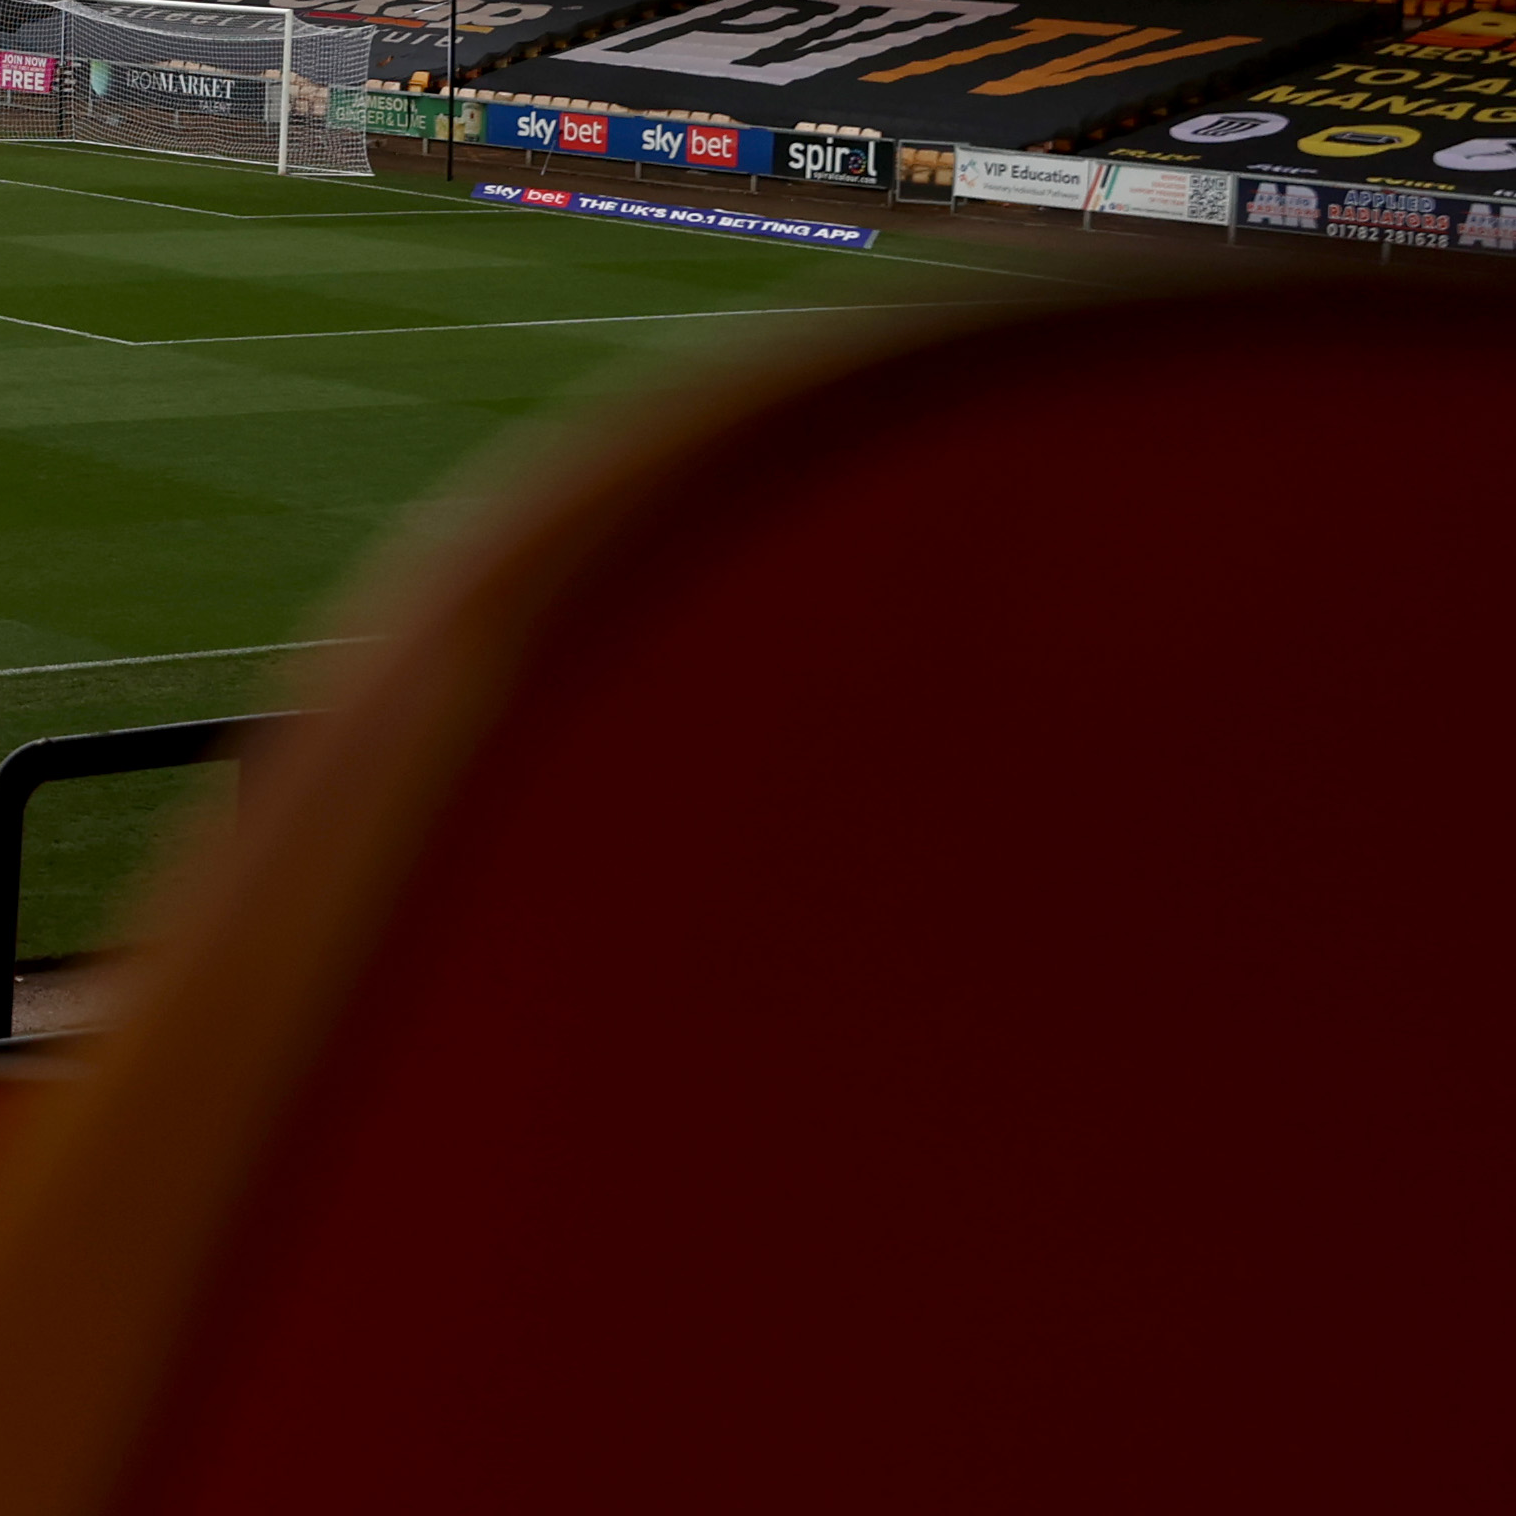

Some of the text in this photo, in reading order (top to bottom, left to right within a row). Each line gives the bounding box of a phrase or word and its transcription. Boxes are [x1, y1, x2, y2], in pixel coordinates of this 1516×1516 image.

[2, 54, 46, 67] JOIN NOW
[1, 70, 45, 91] FREE
[127, 68, 235, 99] IRONMARKET
[517, 111, 602, 145] sky bet
[642, 124, 732, 159] sky bet
[813, 171, 877, 184] spiralcolour.com
[984, 163, 1080, 185] VIP Education
[482, 184, 861, 241] sky bet THE UK'S NO.1 BETTING APP
[1343, 189, 1436, 213] APPLIED
[1327, 204, 1451, 230] RADIATORS
[1326, 223, 1449, 248] 01782 281628
